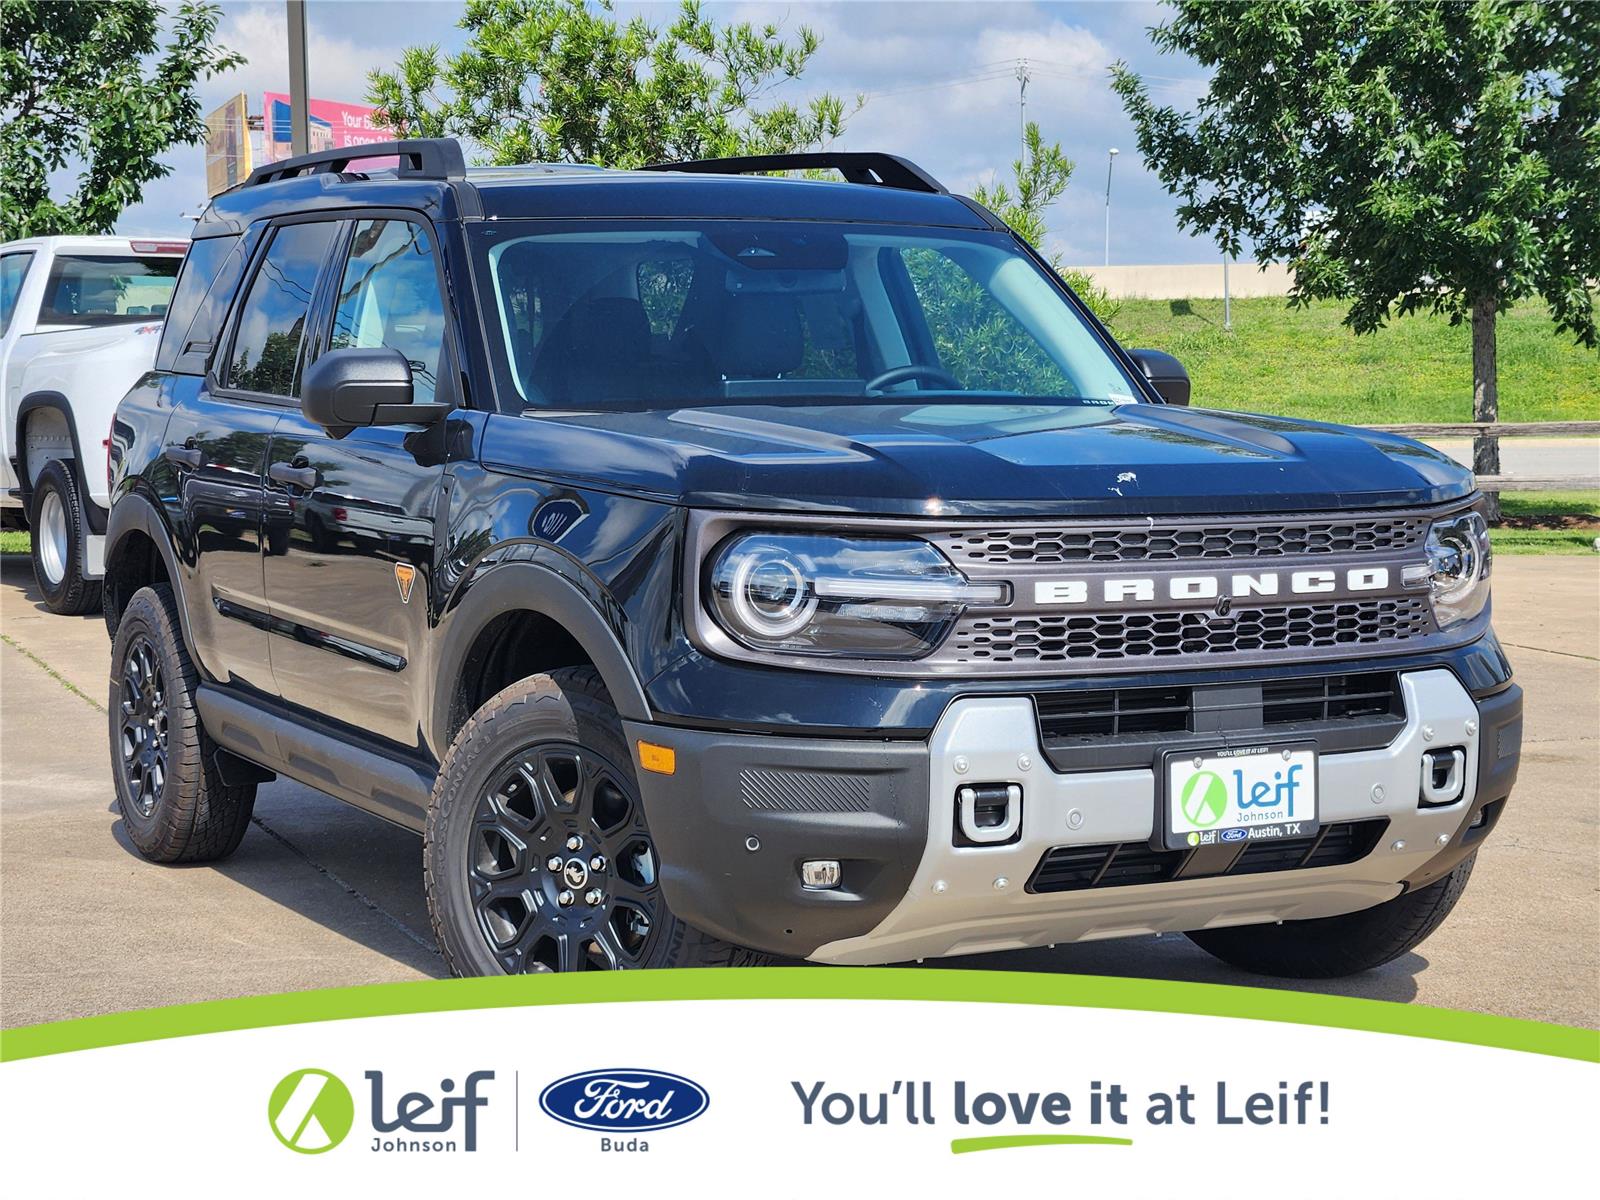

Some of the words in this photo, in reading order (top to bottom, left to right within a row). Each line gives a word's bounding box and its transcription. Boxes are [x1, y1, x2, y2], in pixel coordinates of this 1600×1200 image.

[342, 111, 362, 128] Your
[1034, 567, 1389, 604] BRONCO
[1236, 810, 1284, 823] Johnson
[1247, 827, 1283, 840] Austin,
[1285, 823, 1301, 835] TX
